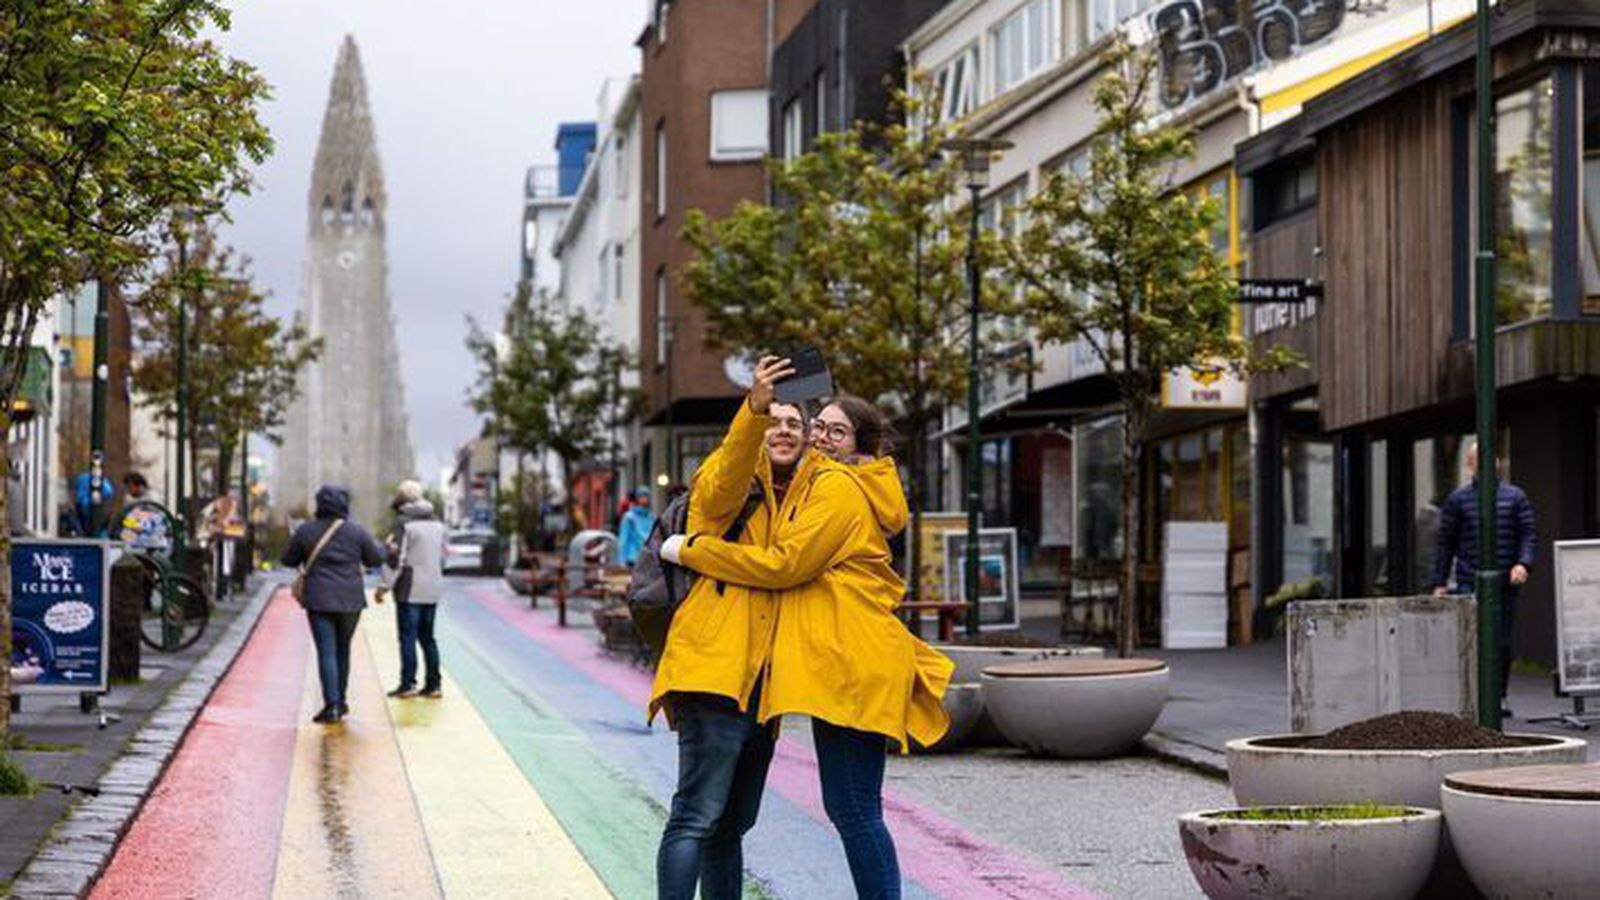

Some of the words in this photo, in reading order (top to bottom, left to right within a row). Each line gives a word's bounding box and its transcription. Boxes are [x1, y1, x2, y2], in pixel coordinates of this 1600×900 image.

[1240, 283, 1274, 297] fine
[1277, 285, 1298, 297] art
[41, 565, 74, 581] ICE
[22, 582, 83, 593] ICEBAR
